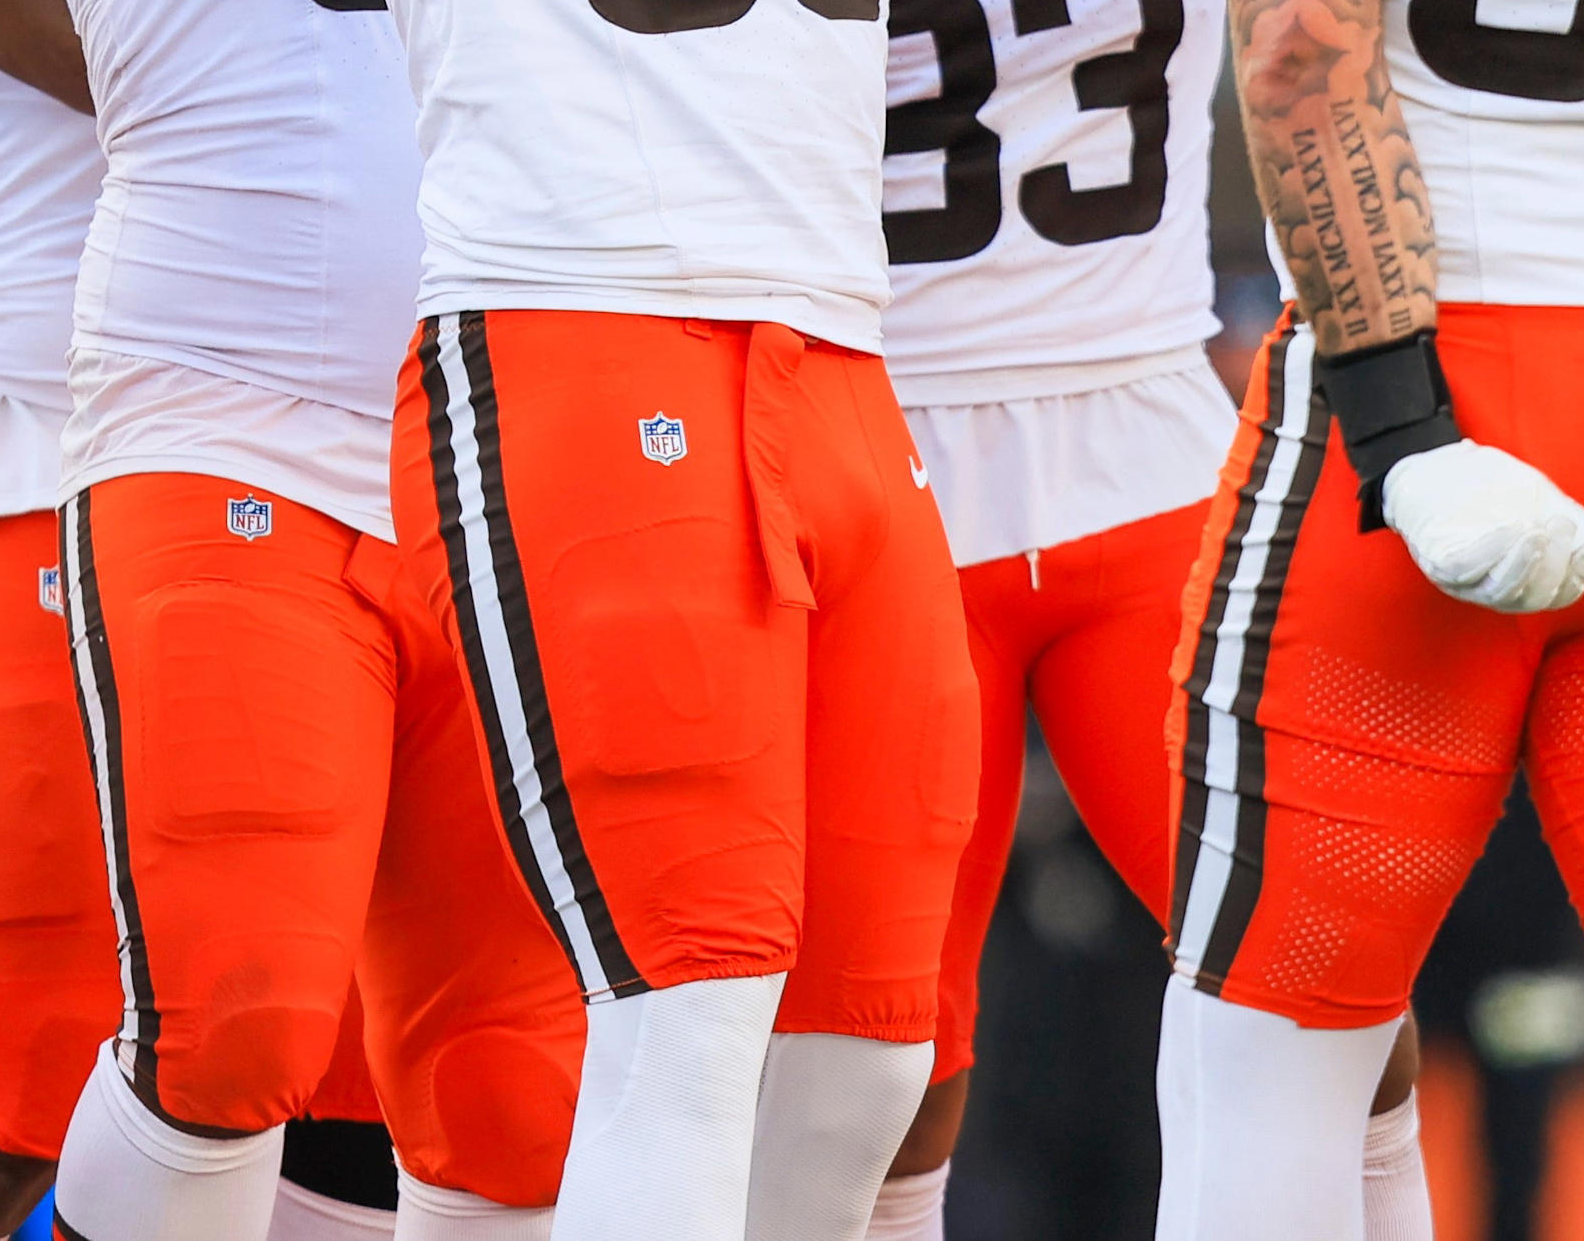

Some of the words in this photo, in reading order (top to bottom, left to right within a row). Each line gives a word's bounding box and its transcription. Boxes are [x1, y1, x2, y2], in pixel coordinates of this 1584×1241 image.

[1370, 239, 1408, 301] XXVI
[1331, 275, 1363, 318] XX
[1388, 307, 1413, 337] III
[648, 436, 680, 455] NFL
[235, 514, 265, 531] NFL
